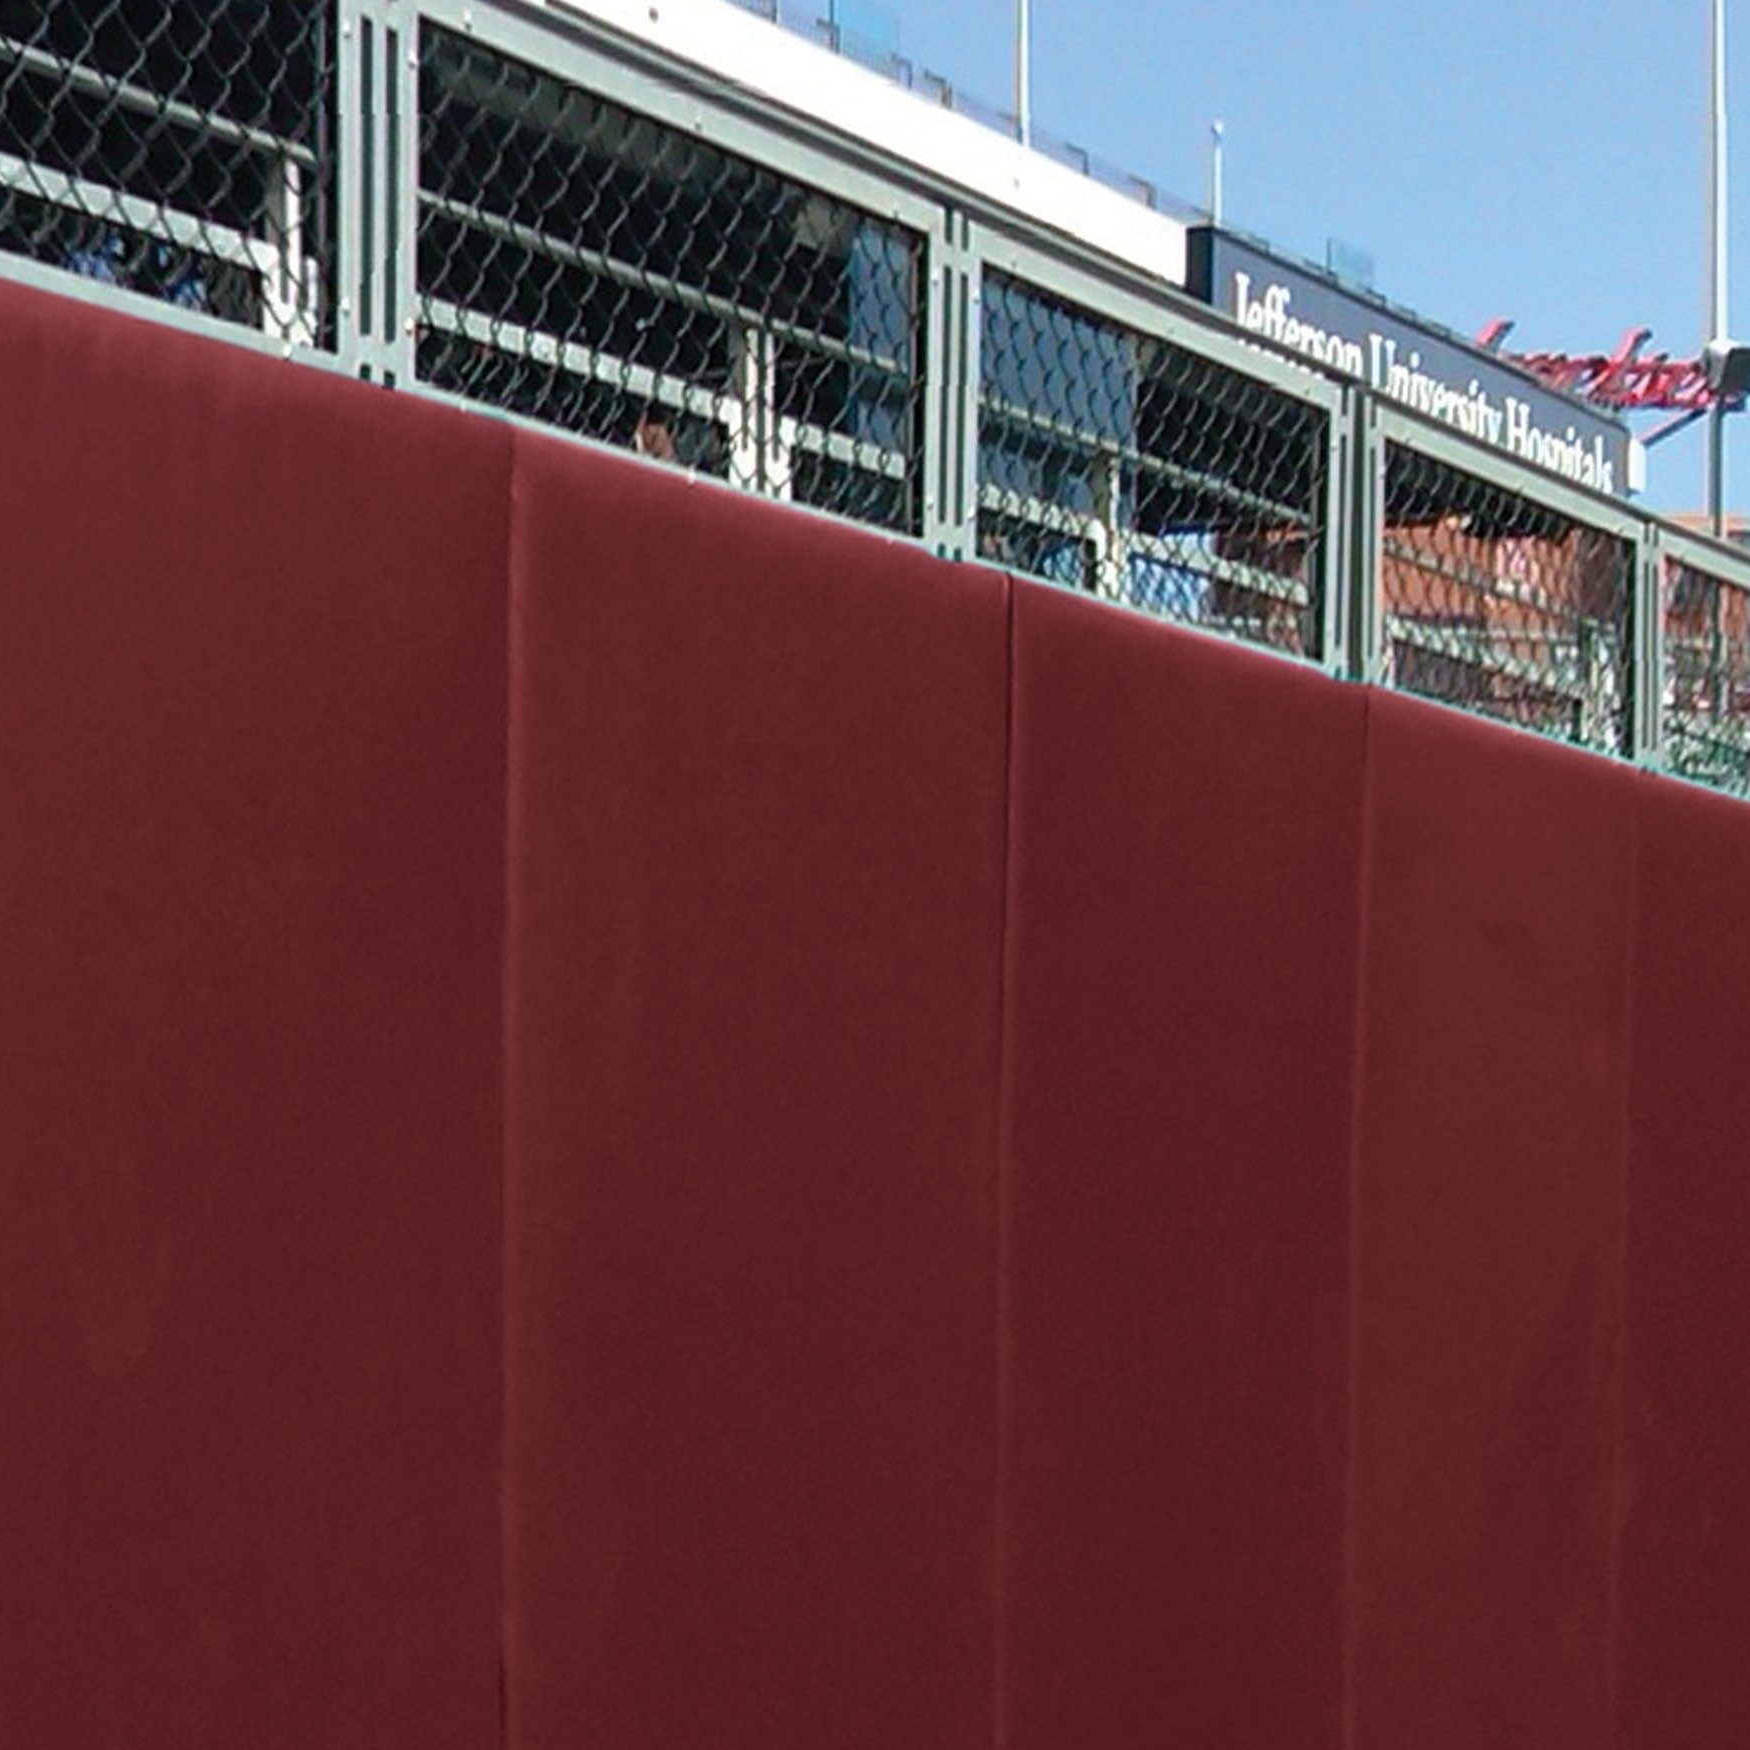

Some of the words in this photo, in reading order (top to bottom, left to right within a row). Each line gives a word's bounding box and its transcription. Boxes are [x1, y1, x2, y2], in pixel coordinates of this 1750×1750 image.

[1235, 271, 1363, 377] Jefferson
[1369, 333, 1503, 442] University
[1505, 397, 1614, 495] Hospitals
